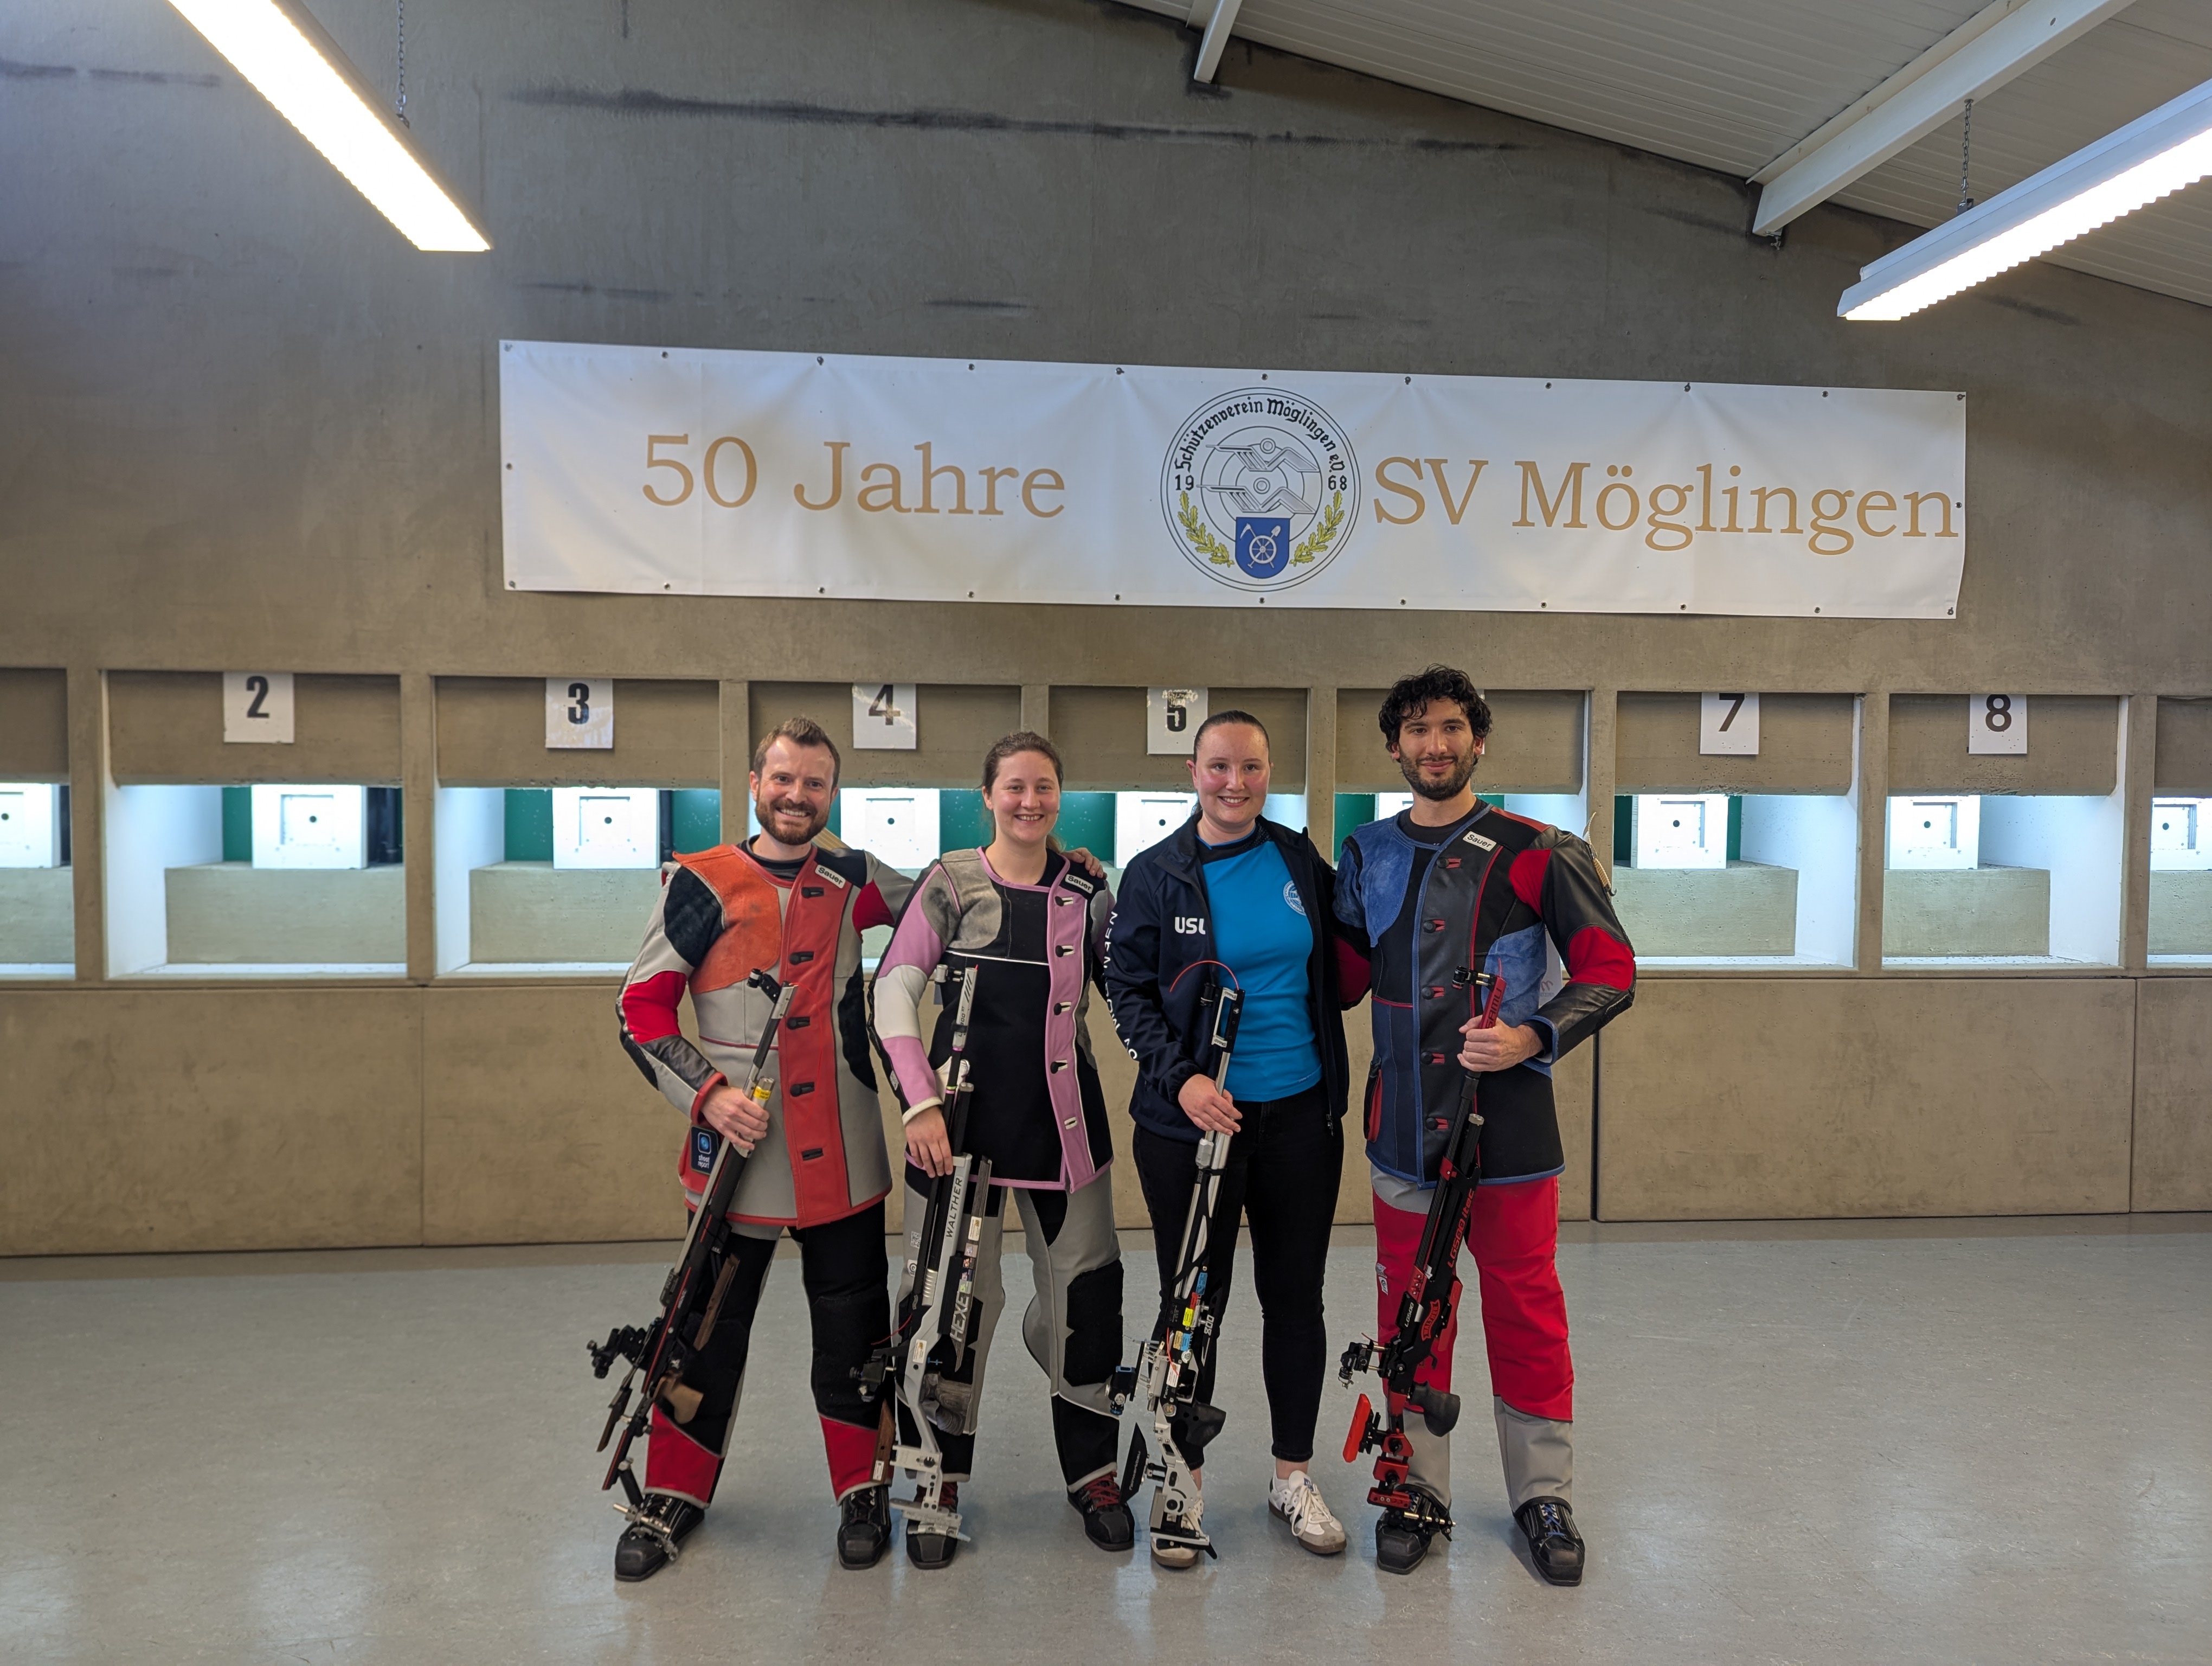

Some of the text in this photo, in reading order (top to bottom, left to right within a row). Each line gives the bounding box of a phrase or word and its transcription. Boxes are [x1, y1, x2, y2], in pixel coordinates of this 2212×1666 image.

[1174, 396, 1263, 472] Schützenverein
[1266, 398, 1337, 452] Möglingen
[642, 433, 1065, 518] 50 Jahre
[1174, 474, 1194, 491] 19
[1328, 475, 1347, 491] 68
[1373, 456, 1959, 556] SV Möglingen
[245, 675, 269, 719] 2
[567, 682, 589, 725] 3
[868, 684, 901, 726] 4
[1166, 691, 1187, 732] 5
[1718, 693, 1745, 733] 7
[1985, 694, 2012, 733] 8
[1467, 834, 1492, 848] Sauer
[818, 867, 843, 885] Sauer
[1068, 876, 1092, 890] Sauer
[946, 1178, 962, 1239] WALTHER
[1447, 1218, 1465, 1268] LG500
[950, 1291, 969, 1343] HEXE
[1204, 1314, 1214, 1336] 800
